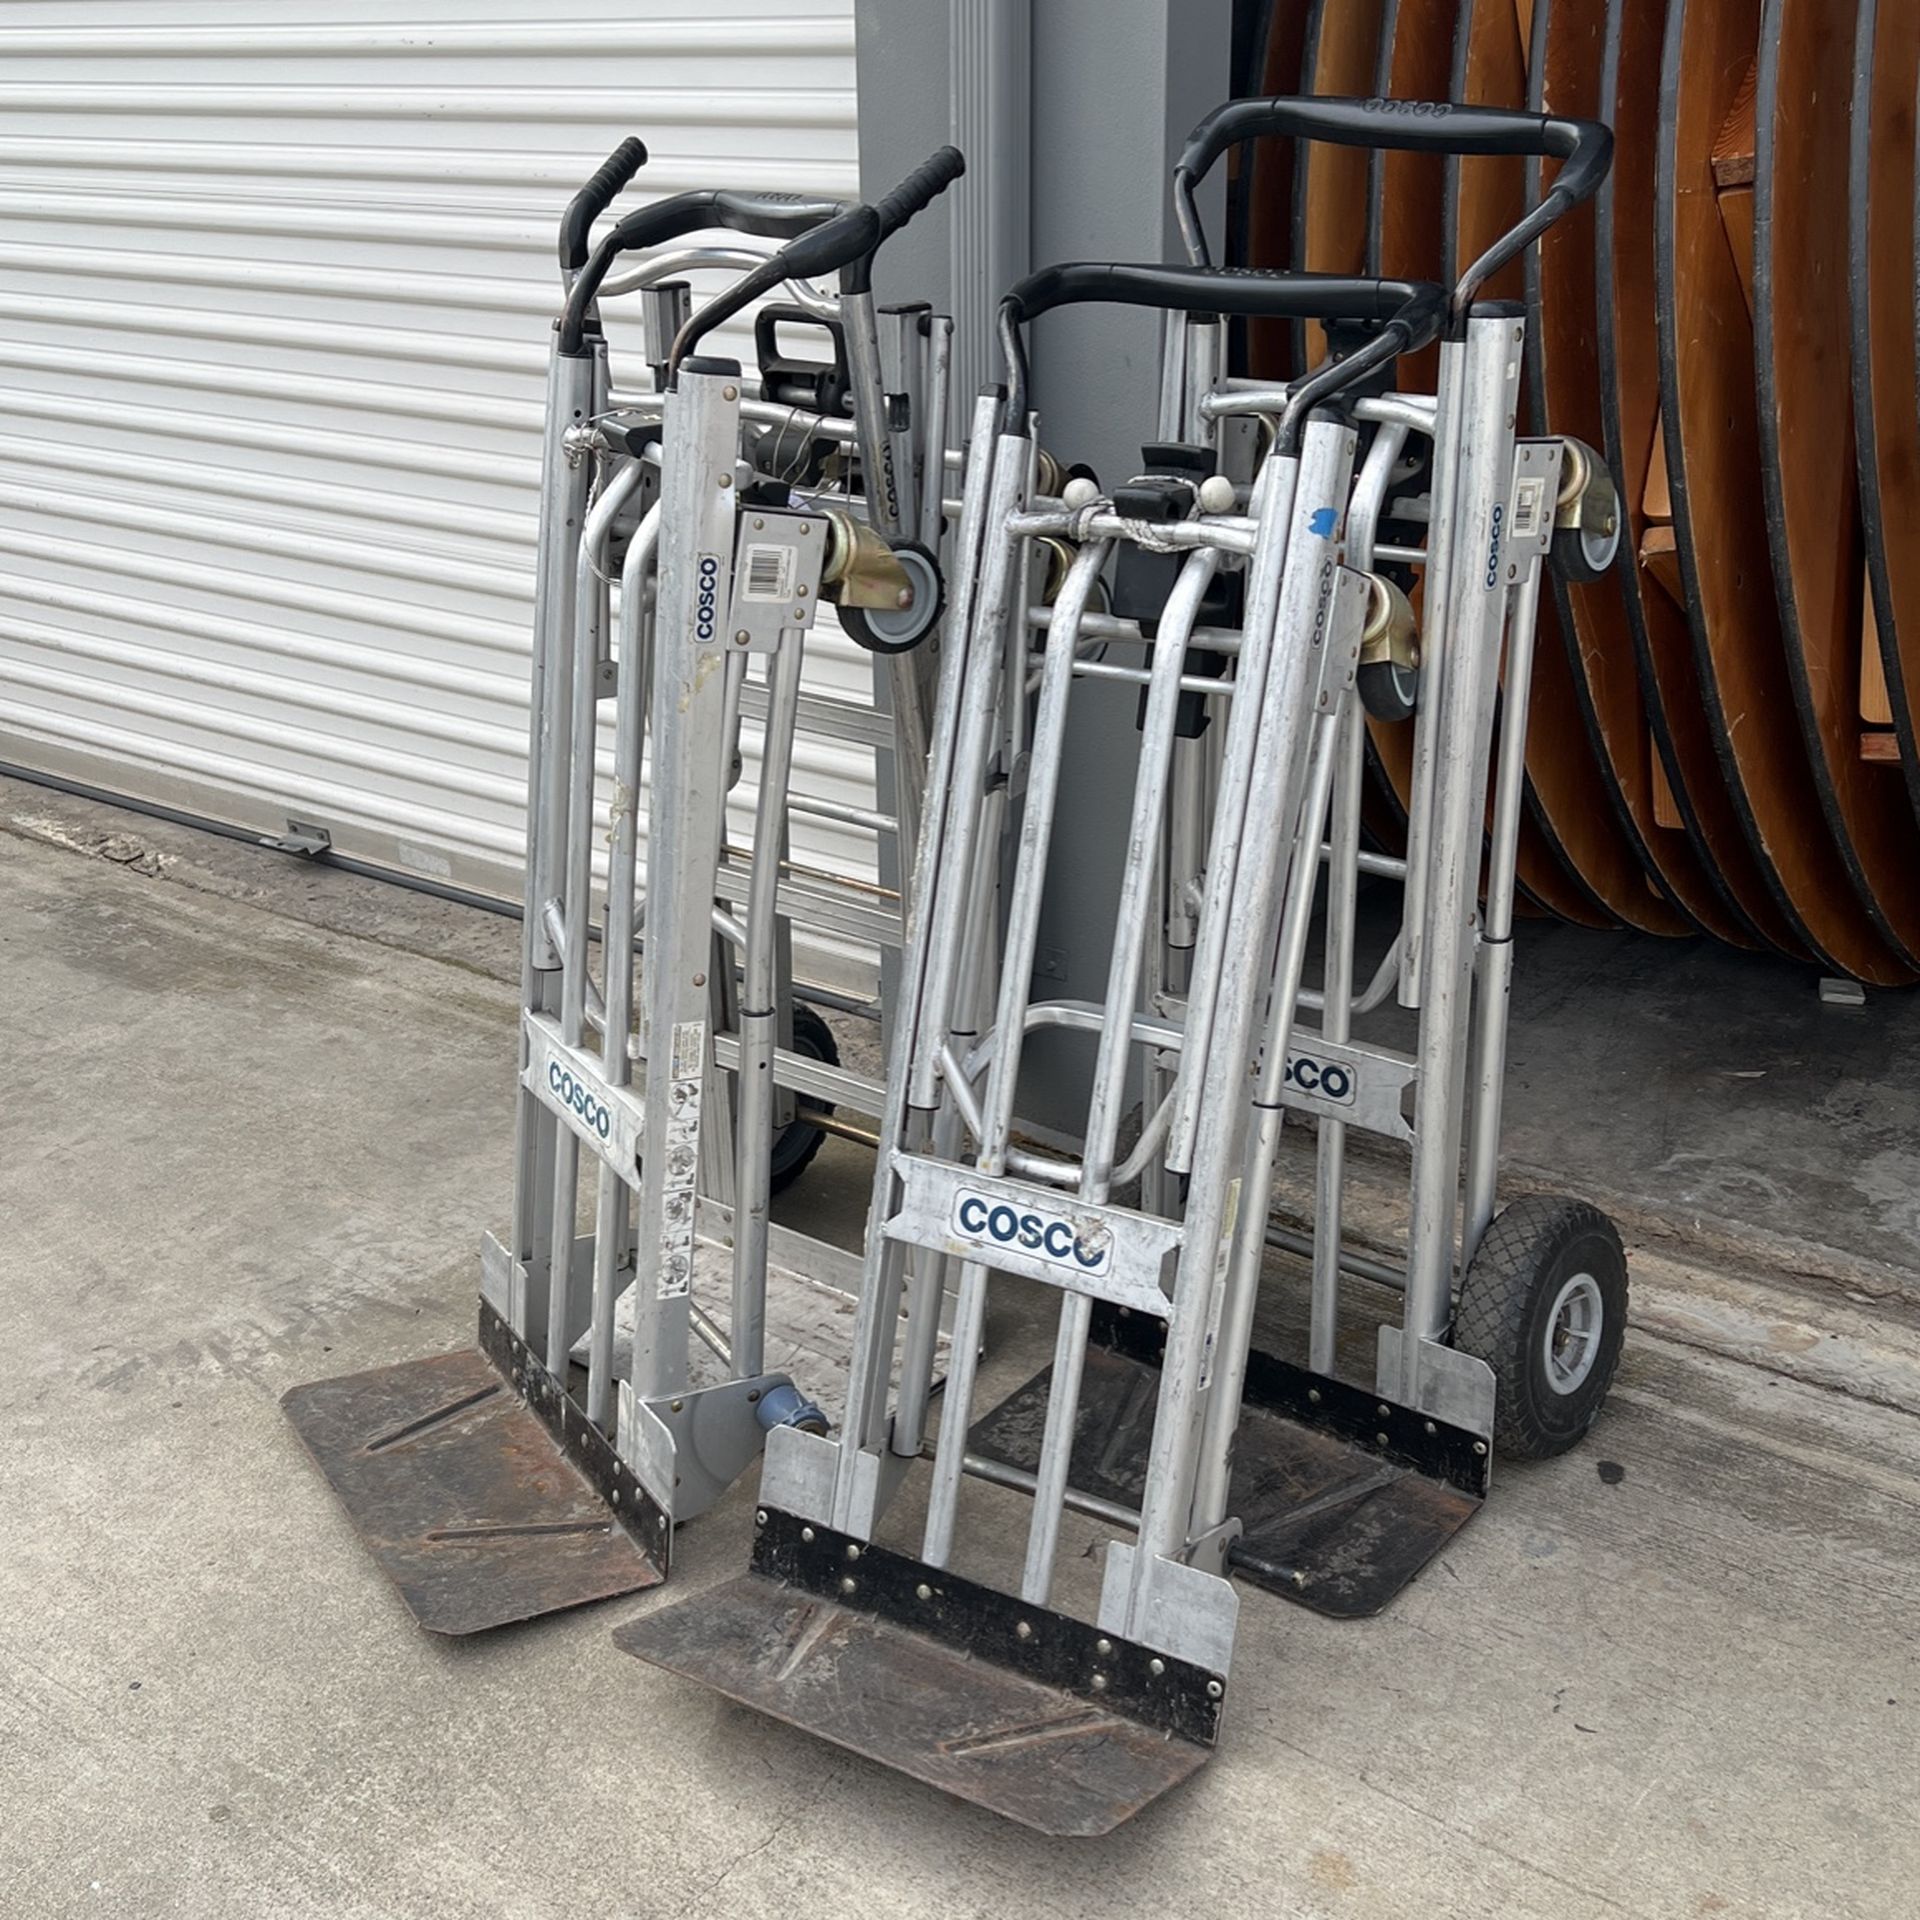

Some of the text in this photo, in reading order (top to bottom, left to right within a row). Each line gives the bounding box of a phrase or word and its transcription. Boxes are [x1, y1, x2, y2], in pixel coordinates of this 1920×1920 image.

[1487, 507, 1502, 587] COSCO
[697, 558, 717, 639] COSCO
[1313, 561, 1332, 645] COSCO
[550, 1061, 609, 1138] COSCO
